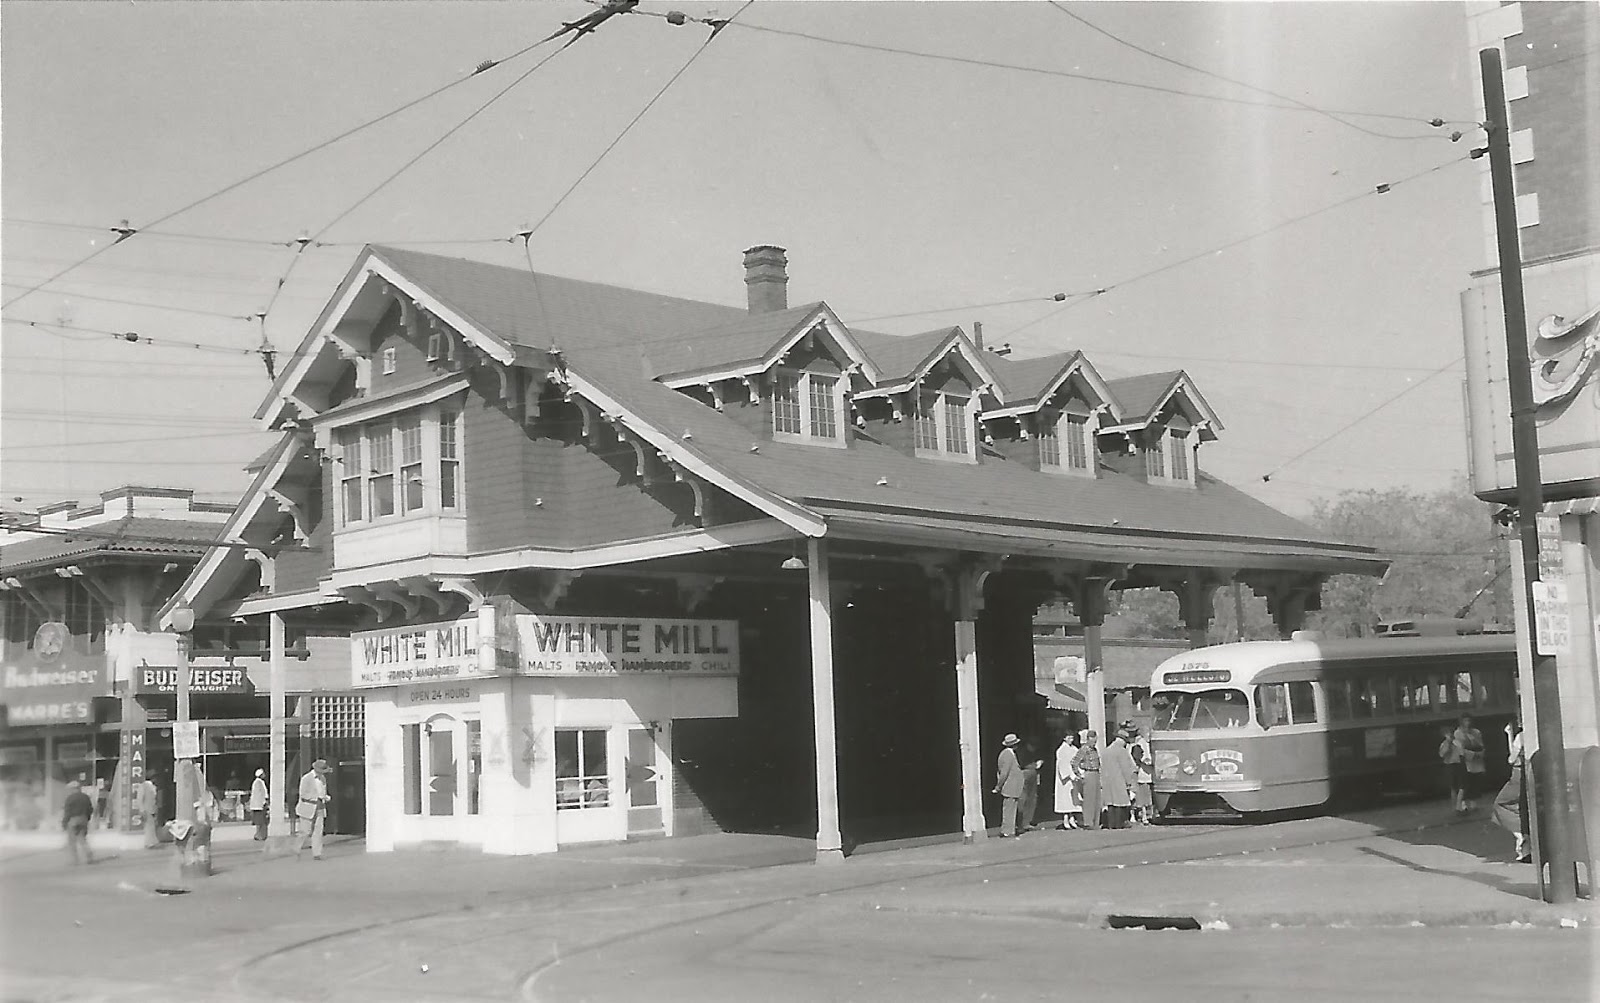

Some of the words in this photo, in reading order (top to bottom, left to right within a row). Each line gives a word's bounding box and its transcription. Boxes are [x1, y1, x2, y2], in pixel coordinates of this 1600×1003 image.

[1541, 538, 1559, 549] BUS
[1546, 585, 1557, 599] NO
[363, 630, 427, 665] WHITE
[436, 625, 479, 659] MIL
[533, 621, 641, 653] WHITE
[654, 624, 729, 654] MILL
[1540, 631, 1568, 647] BLOCK
[528, 660, 562, 671] MALTS
[576, 660, 617, 672] FAMOUS
[621, 658, 691, 672] HAMBURGERS
[701, 660, 731, 671] CHILI
[411, 690, 430, 702] OPEN
[431, 689, 443, 700] 24
[444, 686, 470, 699] HOURS
